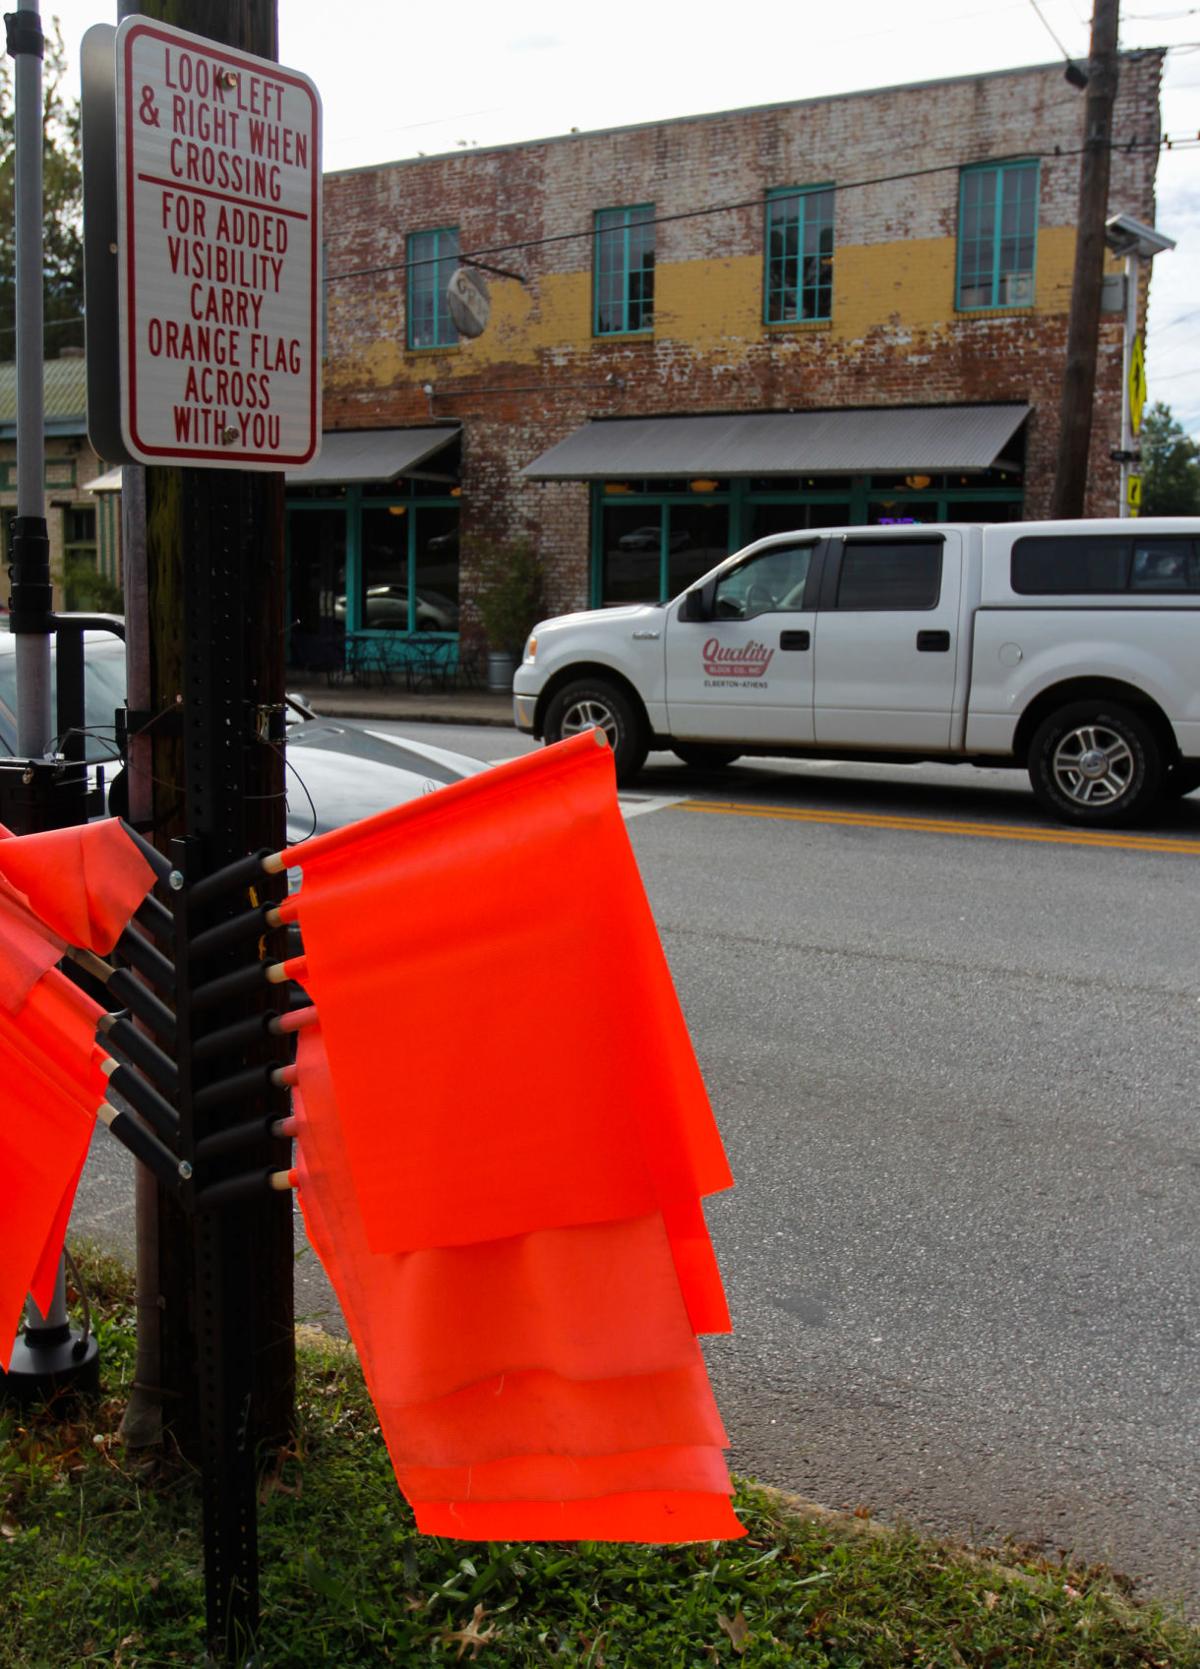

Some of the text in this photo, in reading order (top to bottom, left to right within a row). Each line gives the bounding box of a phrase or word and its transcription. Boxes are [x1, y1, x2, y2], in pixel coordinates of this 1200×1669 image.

[165, 48, 285, 117] LOOK LEFT
[139, 86, 307, 169] & RIGHT WHEN
[170, 138, 281, 202] CROSSING
[161, 192, 289, 255] FOR ADDED
[167, 236, 283, 292] VISIBILITY
[190, 282, 263, 328] CARRY
[148, 319, 301, 374] ORANGE FLAG
[183, 367, 271, 409] ACROSS
[173, 405, 281, 449] WITH YOU
[703, 638, 775, 664] Quality
